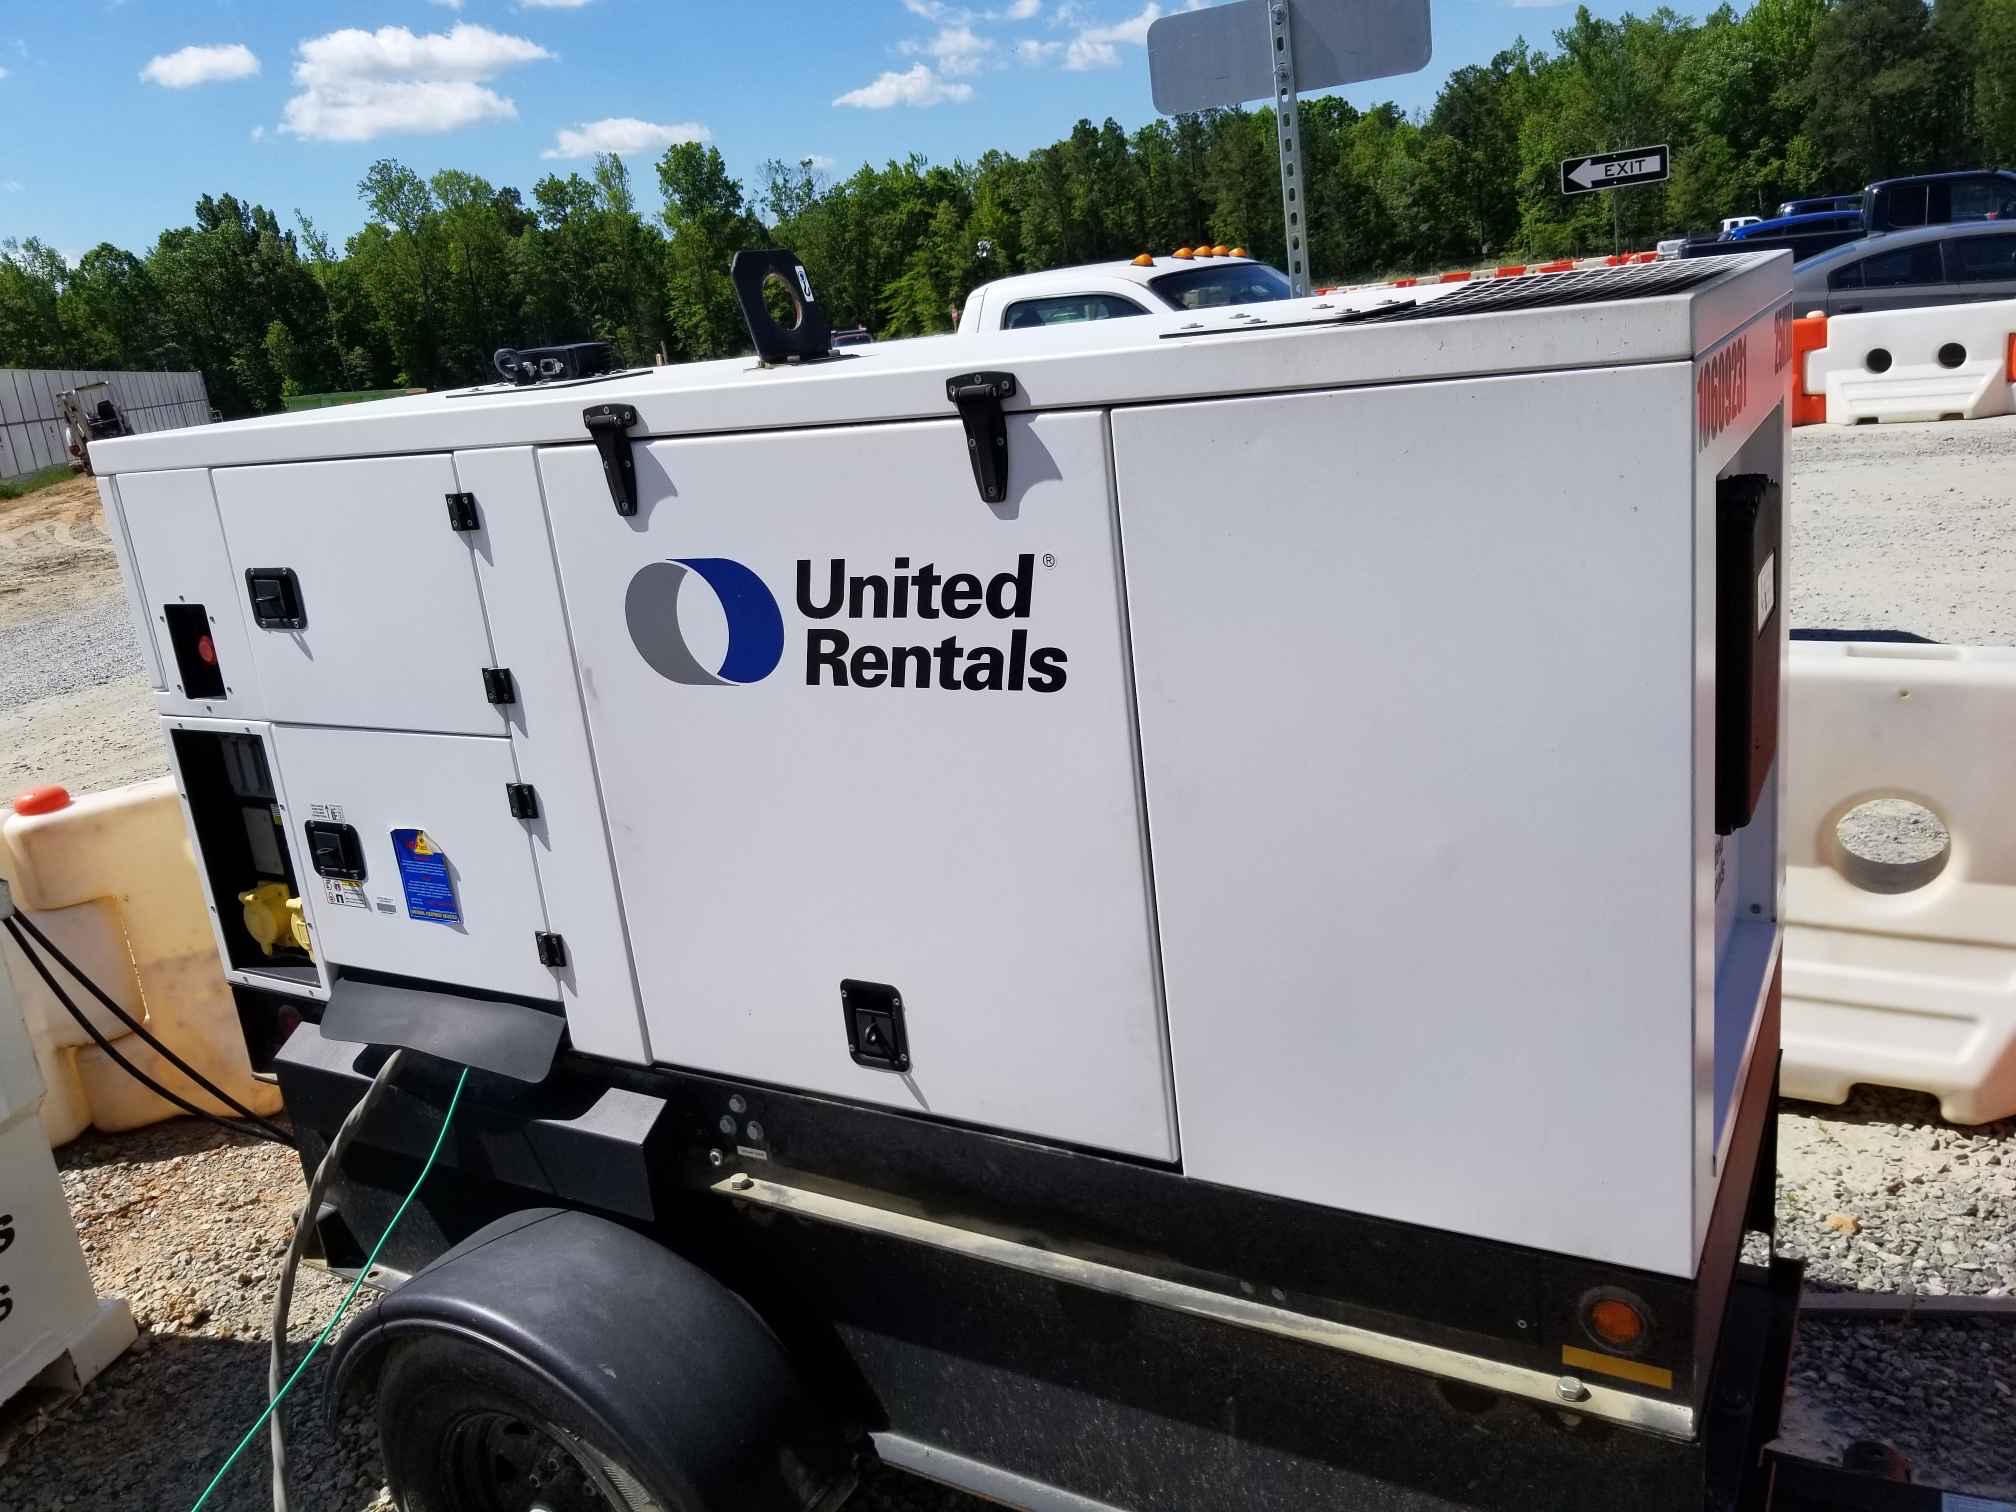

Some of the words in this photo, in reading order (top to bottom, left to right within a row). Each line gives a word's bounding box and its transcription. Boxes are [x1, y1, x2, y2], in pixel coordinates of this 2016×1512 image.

[1604, 160, 1645, 177] EXIT
[1697, 334, 1747, 453] 10609231
[796, 553, 1035, 620] United
[805, 628, 1069, 693] Rentals
